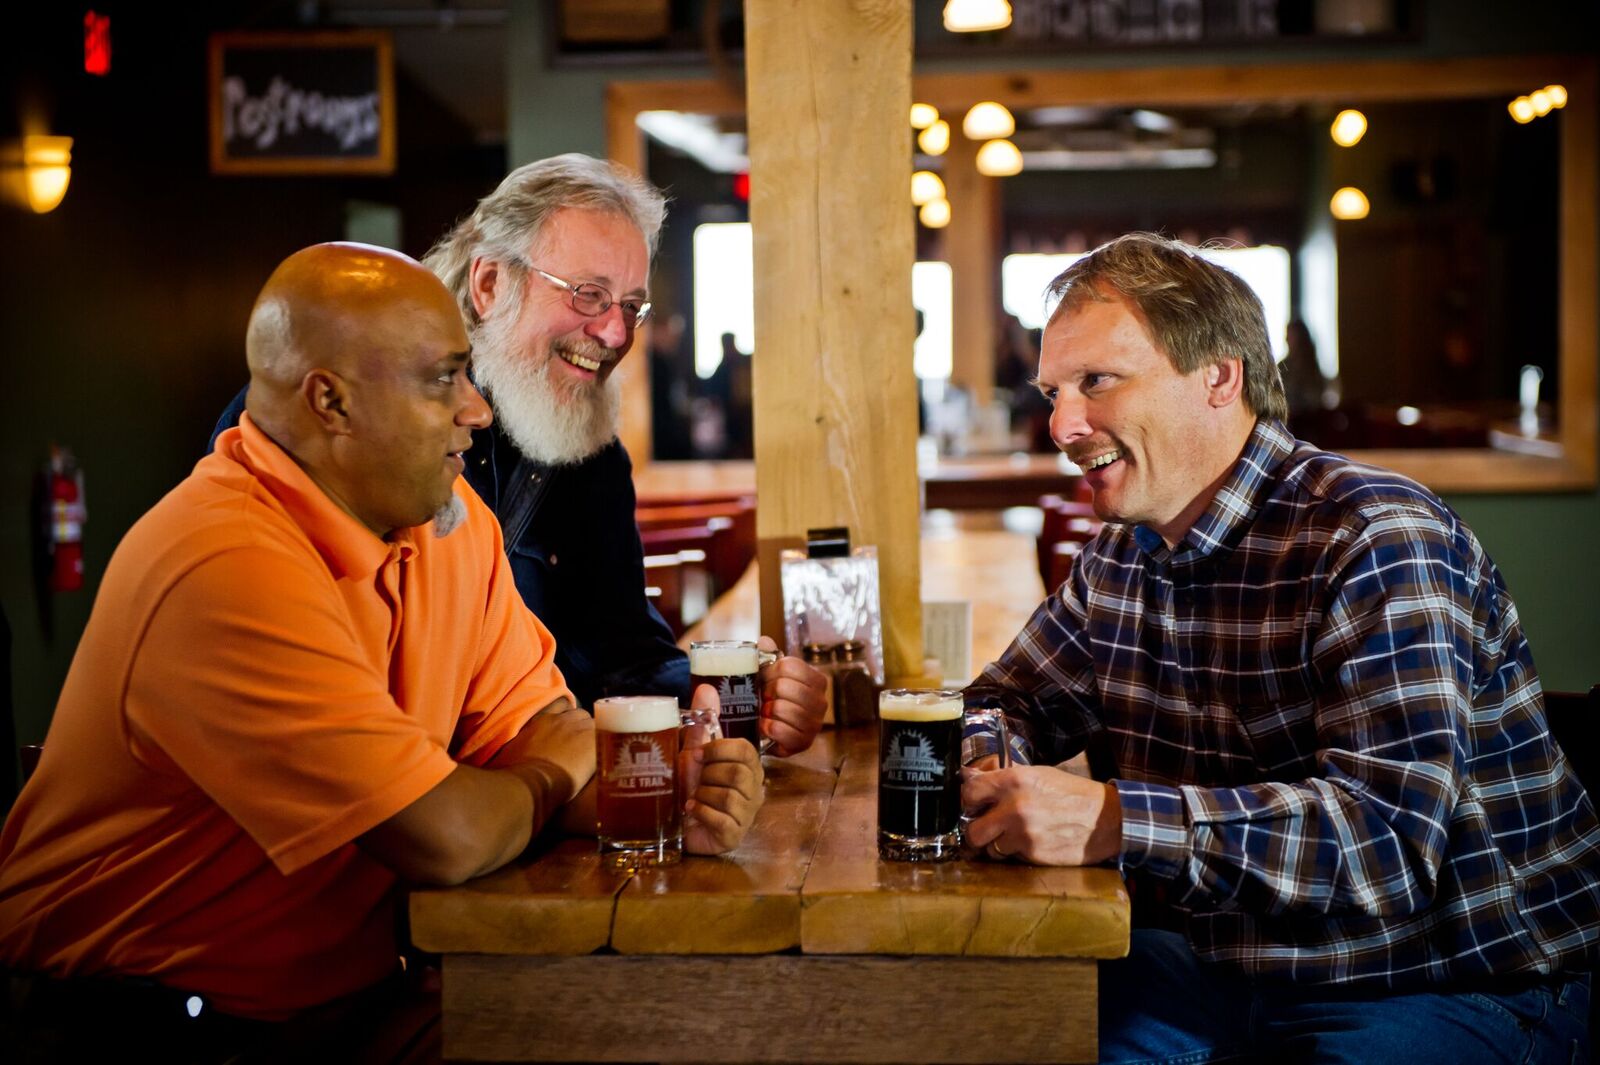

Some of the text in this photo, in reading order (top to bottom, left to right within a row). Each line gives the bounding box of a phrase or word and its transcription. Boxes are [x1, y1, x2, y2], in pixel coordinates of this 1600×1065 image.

[617, 775, 666, 788] ALE TRAIL
[888, 770, 934, 782] ALE TRAIL
